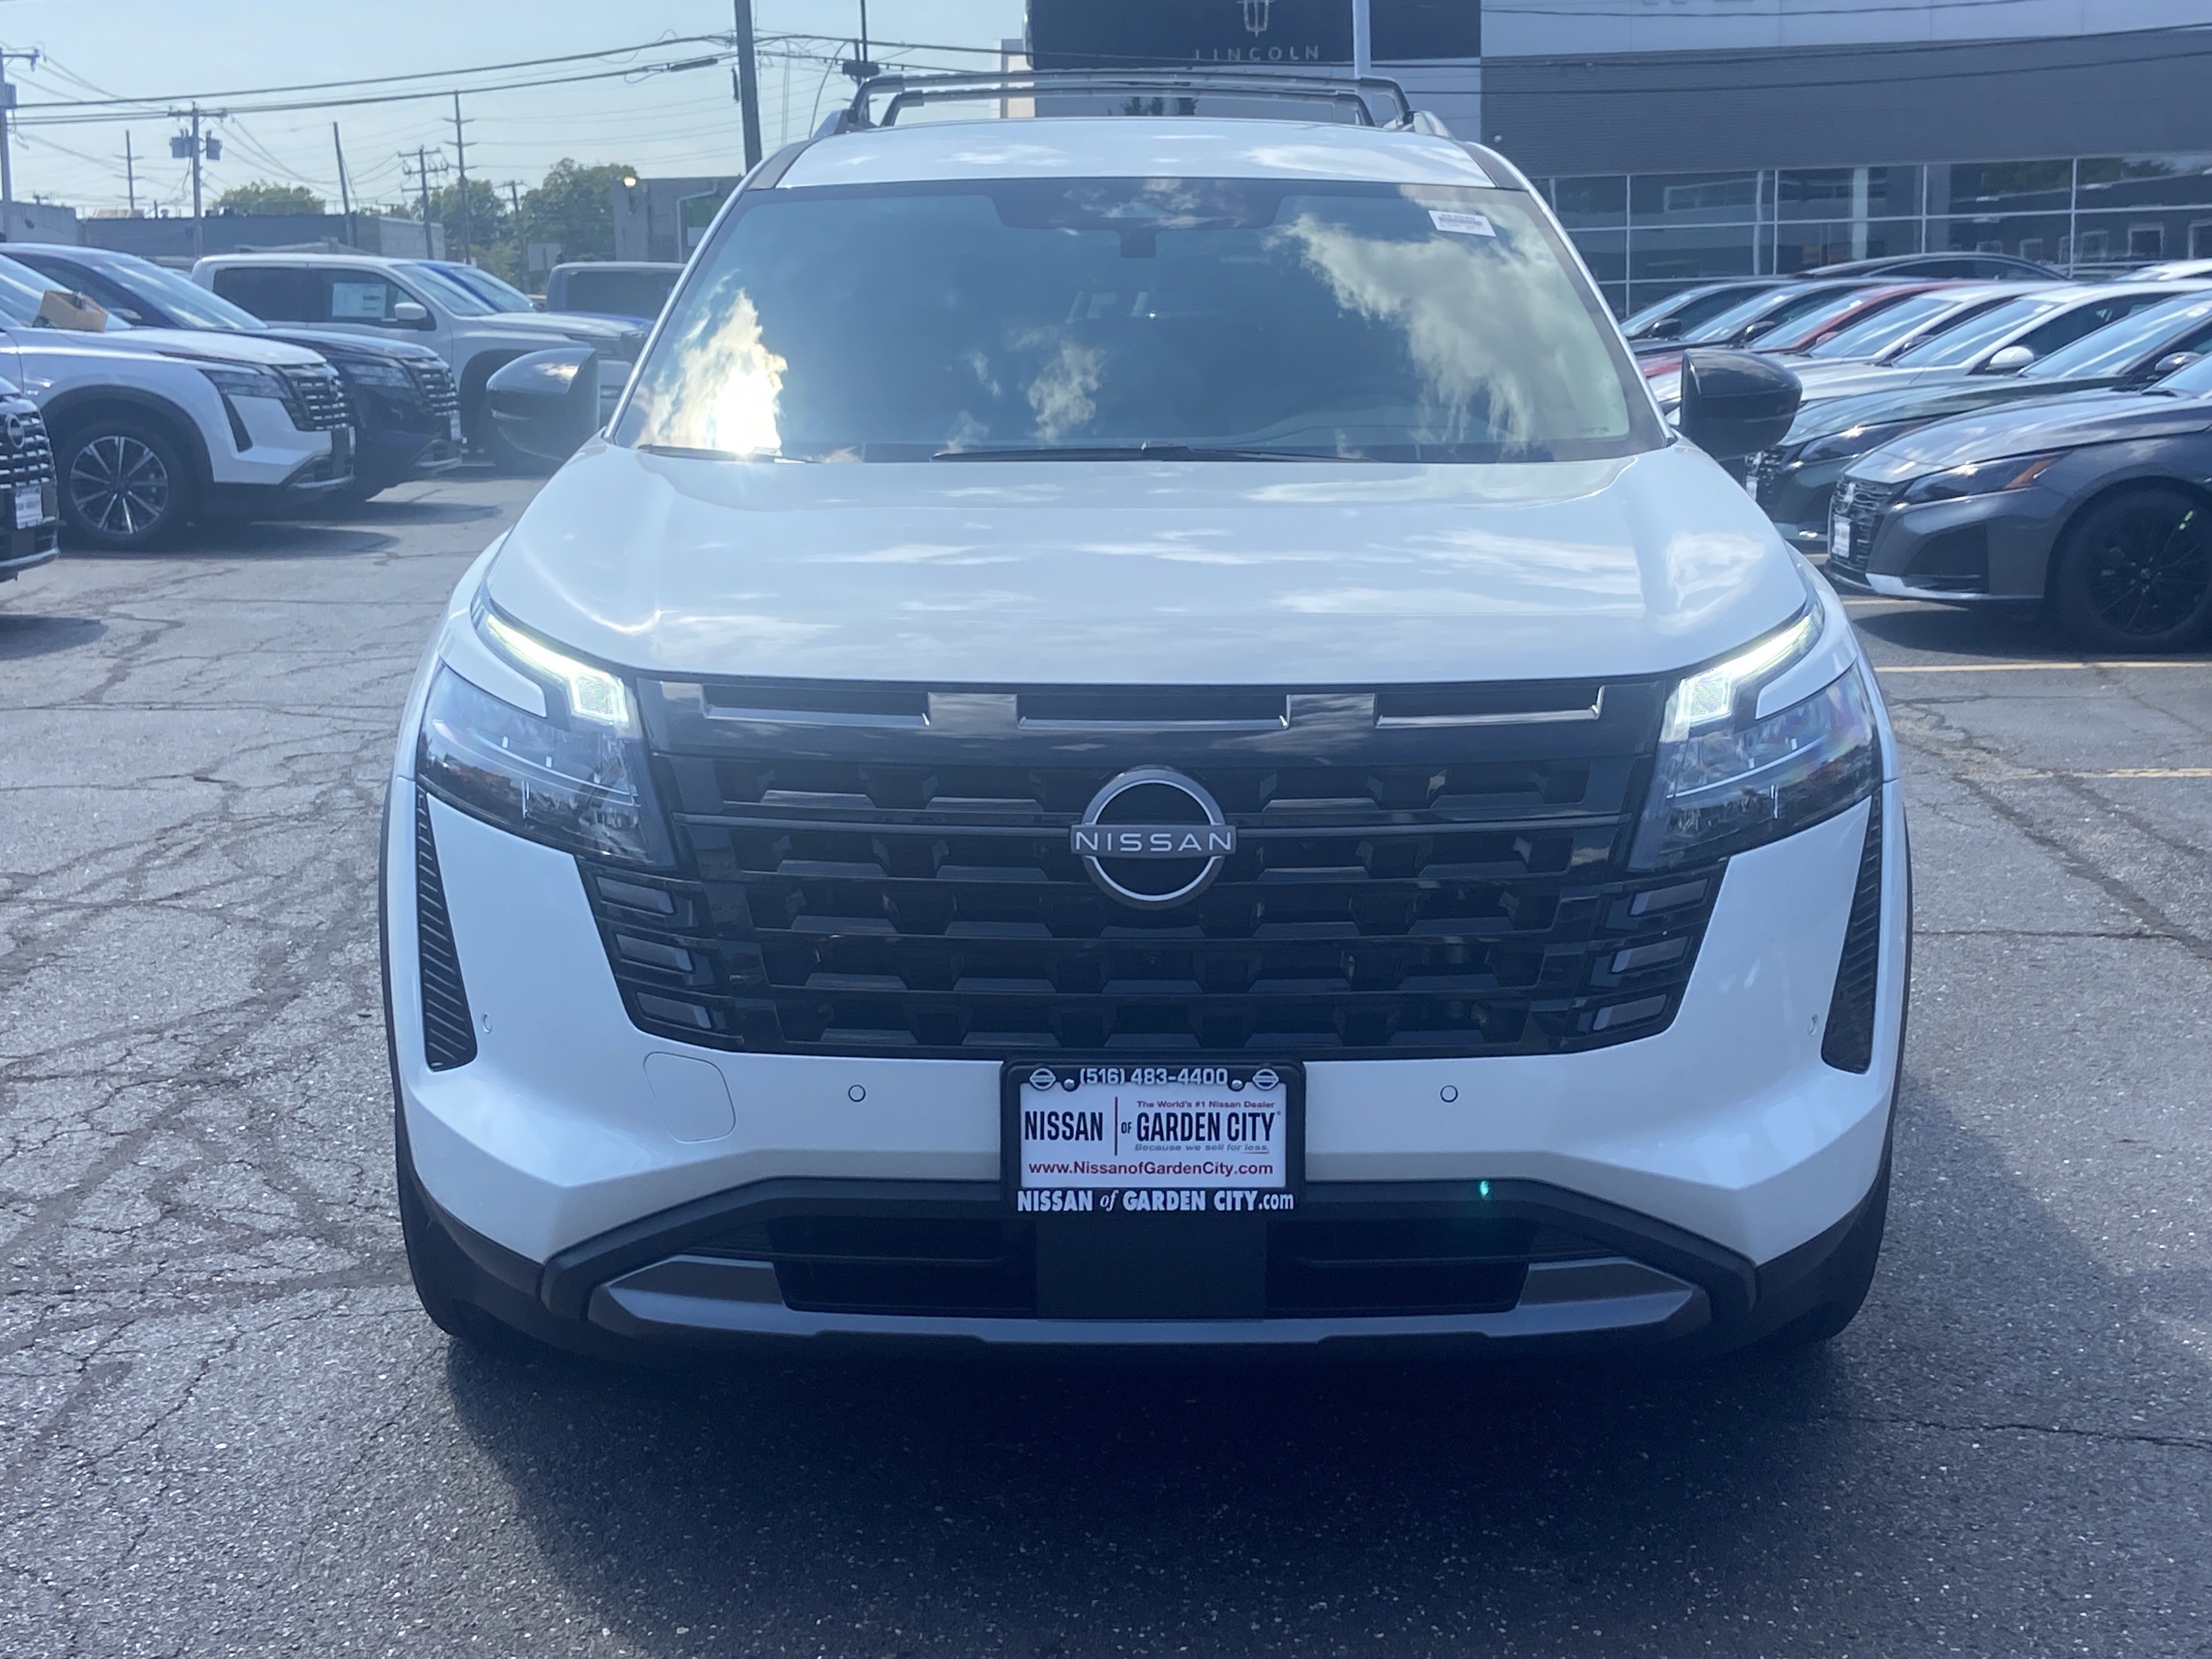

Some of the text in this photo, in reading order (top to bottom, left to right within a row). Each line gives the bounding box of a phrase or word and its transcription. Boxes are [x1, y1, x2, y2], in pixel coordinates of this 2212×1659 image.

[1076, 832, 1231, 851] NISSAN
[1080, 1068, 1228, 1085] (516) 483-4400
[1025, 1111, 1276, 1142] NISSAN OF GARDEN CITY
[1028, 1161, 1273, 1177] www.NissanofGardenCity.com
[1017, 1189, 1294, 1212] NISSAN of GARDEN CITY.com
